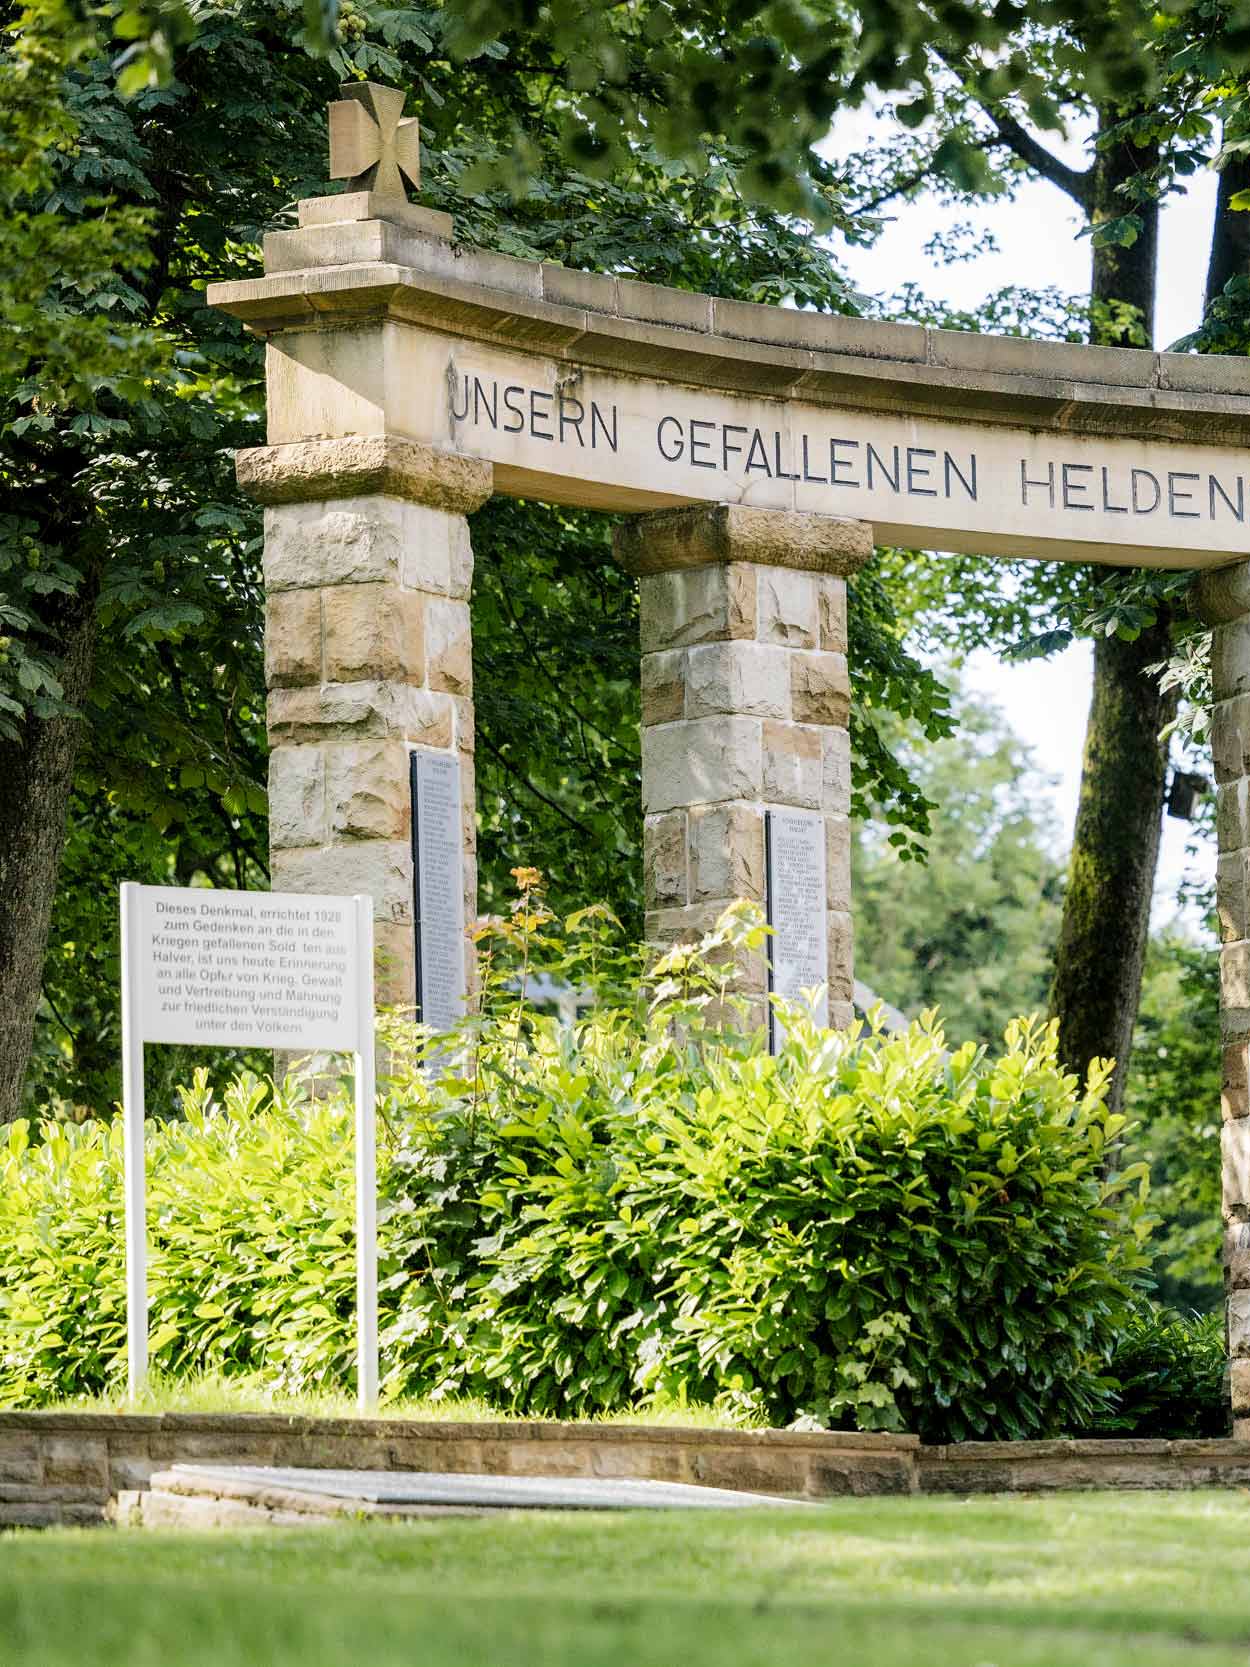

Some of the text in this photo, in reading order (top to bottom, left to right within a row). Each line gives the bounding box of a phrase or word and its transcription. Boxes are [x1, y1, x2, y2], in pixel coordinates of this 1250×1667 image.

[452, 375, 617, 453] UNSERN
[657, 415, 977, 500] GEFALLENEN
[156, 902, 196, 915] Dieses
[200, 903, 256, 919] Denkmal,
[260, 909, 310, 921] errichtet
[164, 921, 189, 930] zum
[193, 919, 254, 934] Gedenken
[258, 926, 272, 936] an
[276, 924, 294, 936] die
[312, 925, 336, 938] den
[152, 935, 199, 949] Kriegen
[203, 937, 265, 952] gefallenen
[198, 953, 213, 964] ist
[216, 956, 238, 966] uns
[242, 956, 276, 969] heute
[280, 956, 346, 974] Erinnerung
[157, 969, 172, 978] an
[175, 968, 196, 980] alle
[236, 973, 259, 984] von
[302, 973, 343, 987] Gewalt
[158, 984, 342, 1006] und Vertreibung und Mahnung
[161, 1002, 182, 1012] zur
[185, 1001, 247, 1015] friedlichen
[195, 1019, 227, 1031] unter
[230, 1019, 253, 1032] den
